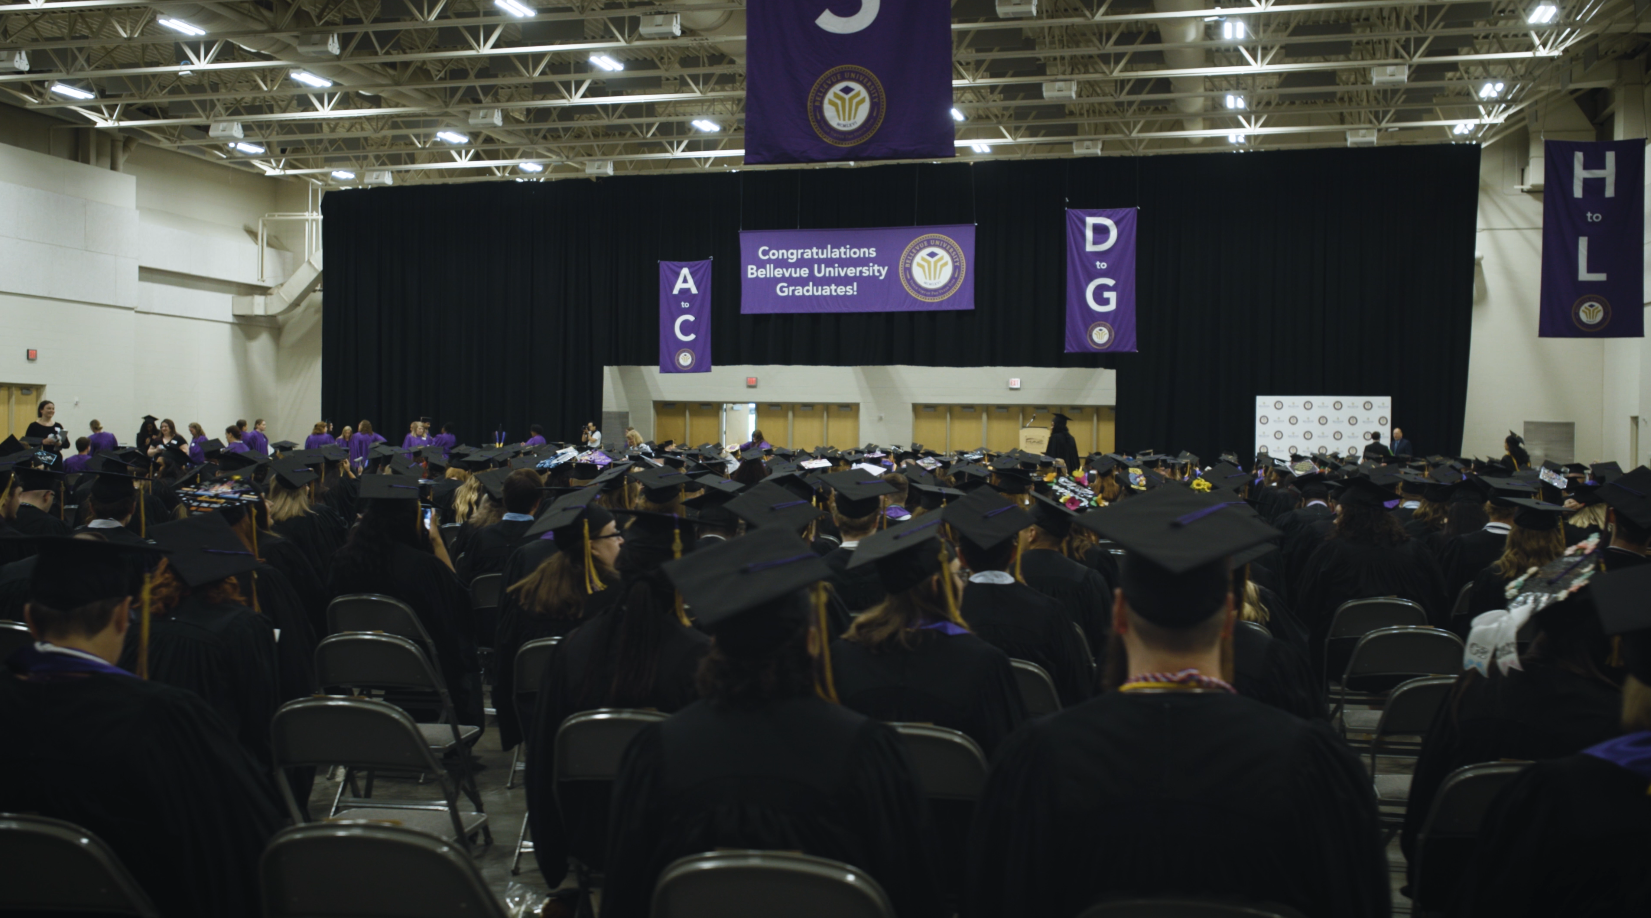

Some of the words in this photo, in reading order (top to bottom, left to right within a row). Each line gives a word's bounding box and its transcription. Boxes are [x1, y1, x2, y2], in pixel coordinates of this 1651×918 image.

[814, 73, 842, 106] BELLEVUE
[844, 72, 879, 102] UNIVERSITY
[1573, 151, 1615, 198] H
[1586, 211, 1602, 222] to
[1085, 217, 1118, 252] D
[758, 244, 877, 262] Congratulations
[905, 240, 929, 268] BELLEVUE
[930, 240, 960, 266] UNIVERSITY
[1096, 260, 1108, 269] to
[1578, 236, 1607, 281] L
[672, 267, 699, 295] A
[747, 264, 809, 278] Bellevue
[814, 263, 888, 279] University
[776, 282, 858, 296] Graduates!
[1085, 278, 1117, 313] G
[674, 314, 697, 342] C
